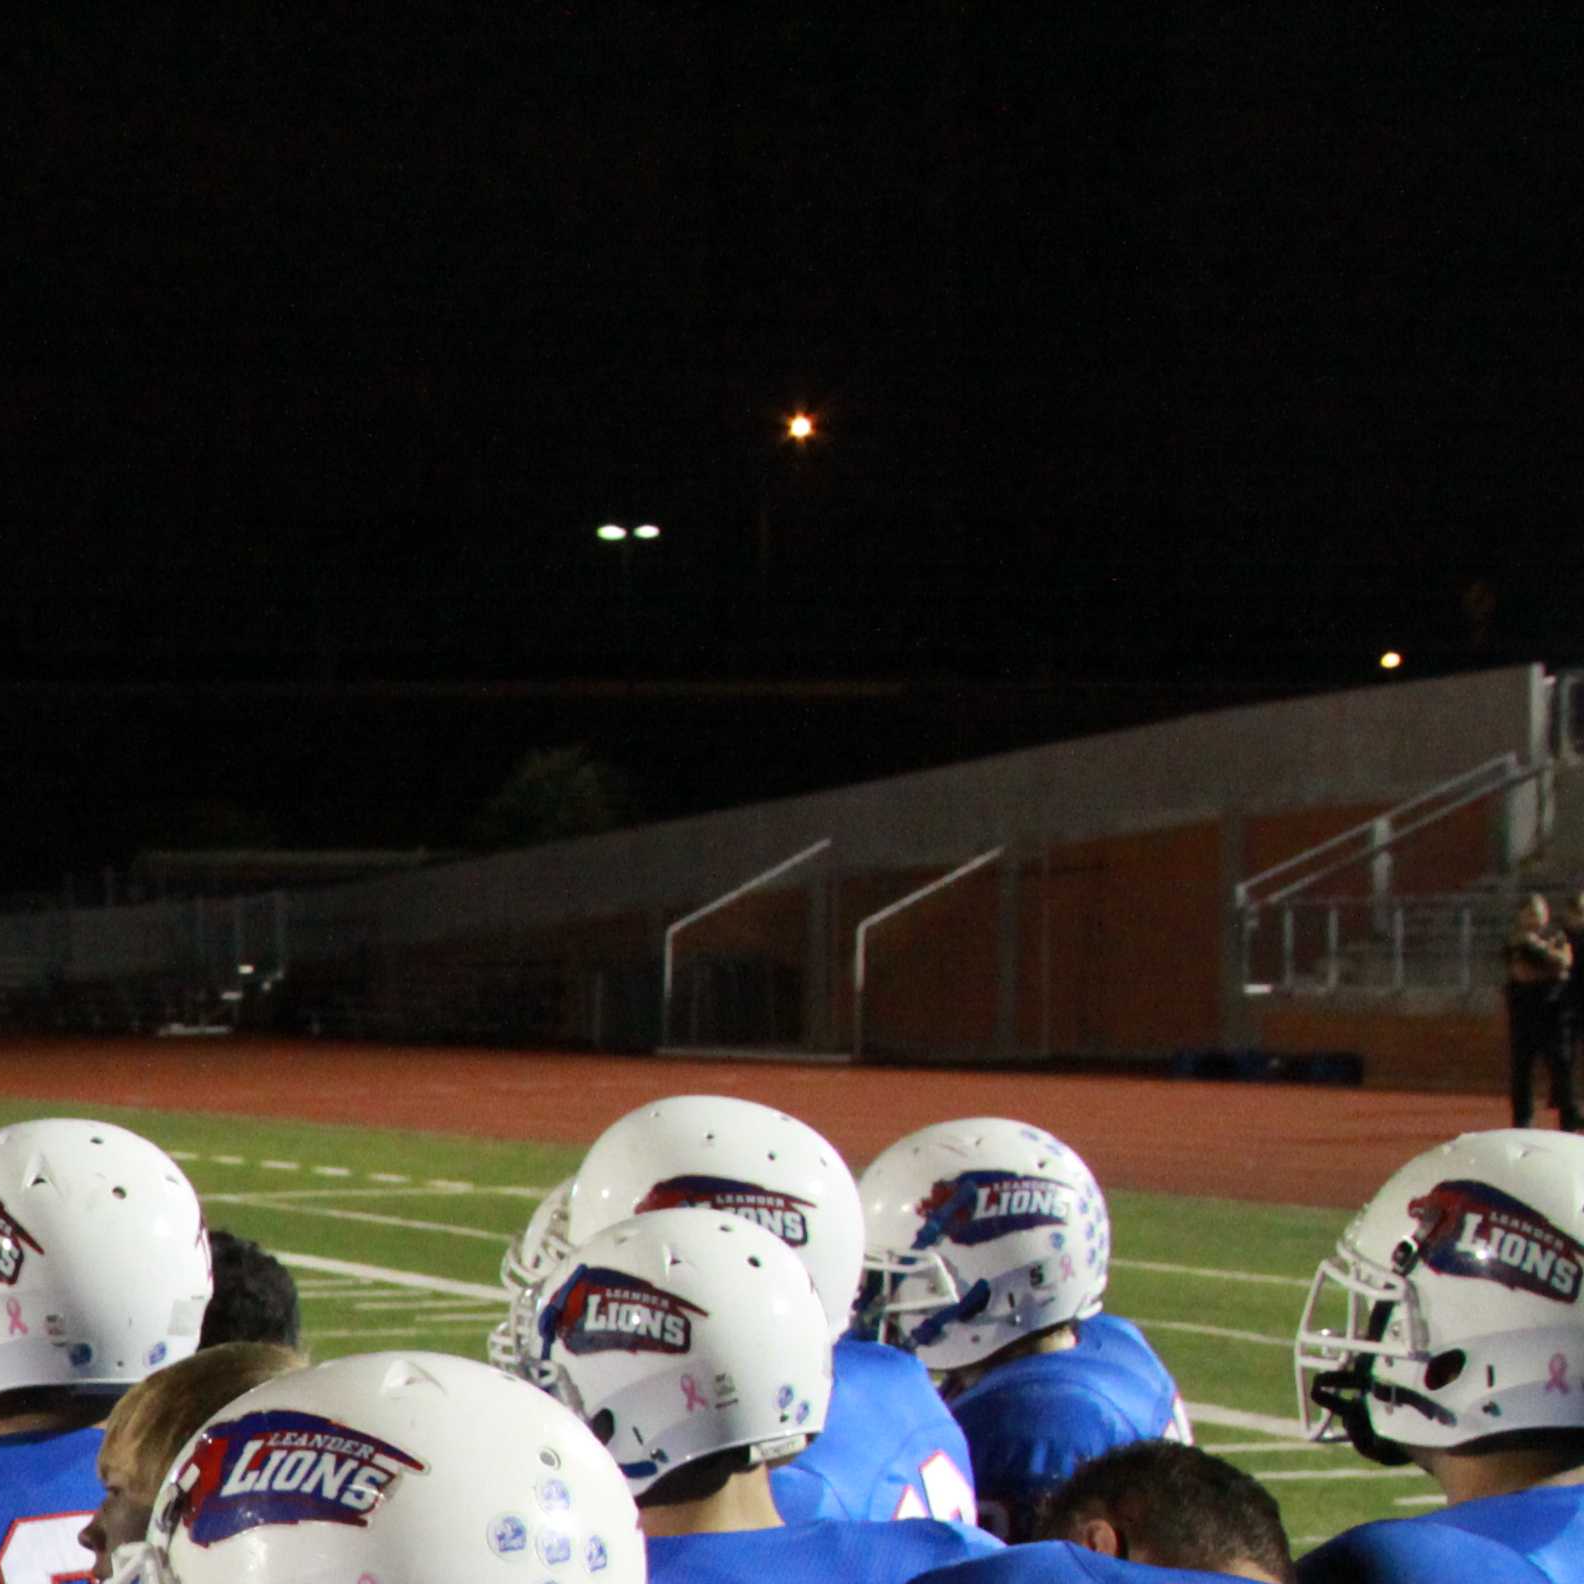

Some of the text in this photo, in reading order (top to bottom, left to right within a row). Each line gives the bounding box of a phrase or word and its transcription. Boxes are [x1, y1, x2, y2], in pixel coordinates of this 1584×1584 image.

[973, 1186, 1070, 1220] LIONS
[1454, 1212, 1580, 1295] LIONS
[1488, 1209, 1567, 1252] LEANDER
[583, 1293, 688, 1348] LIONS
[265, 1430, 376, 1461] LEANDER
[219, 1437, 395, 1514] LIONS
